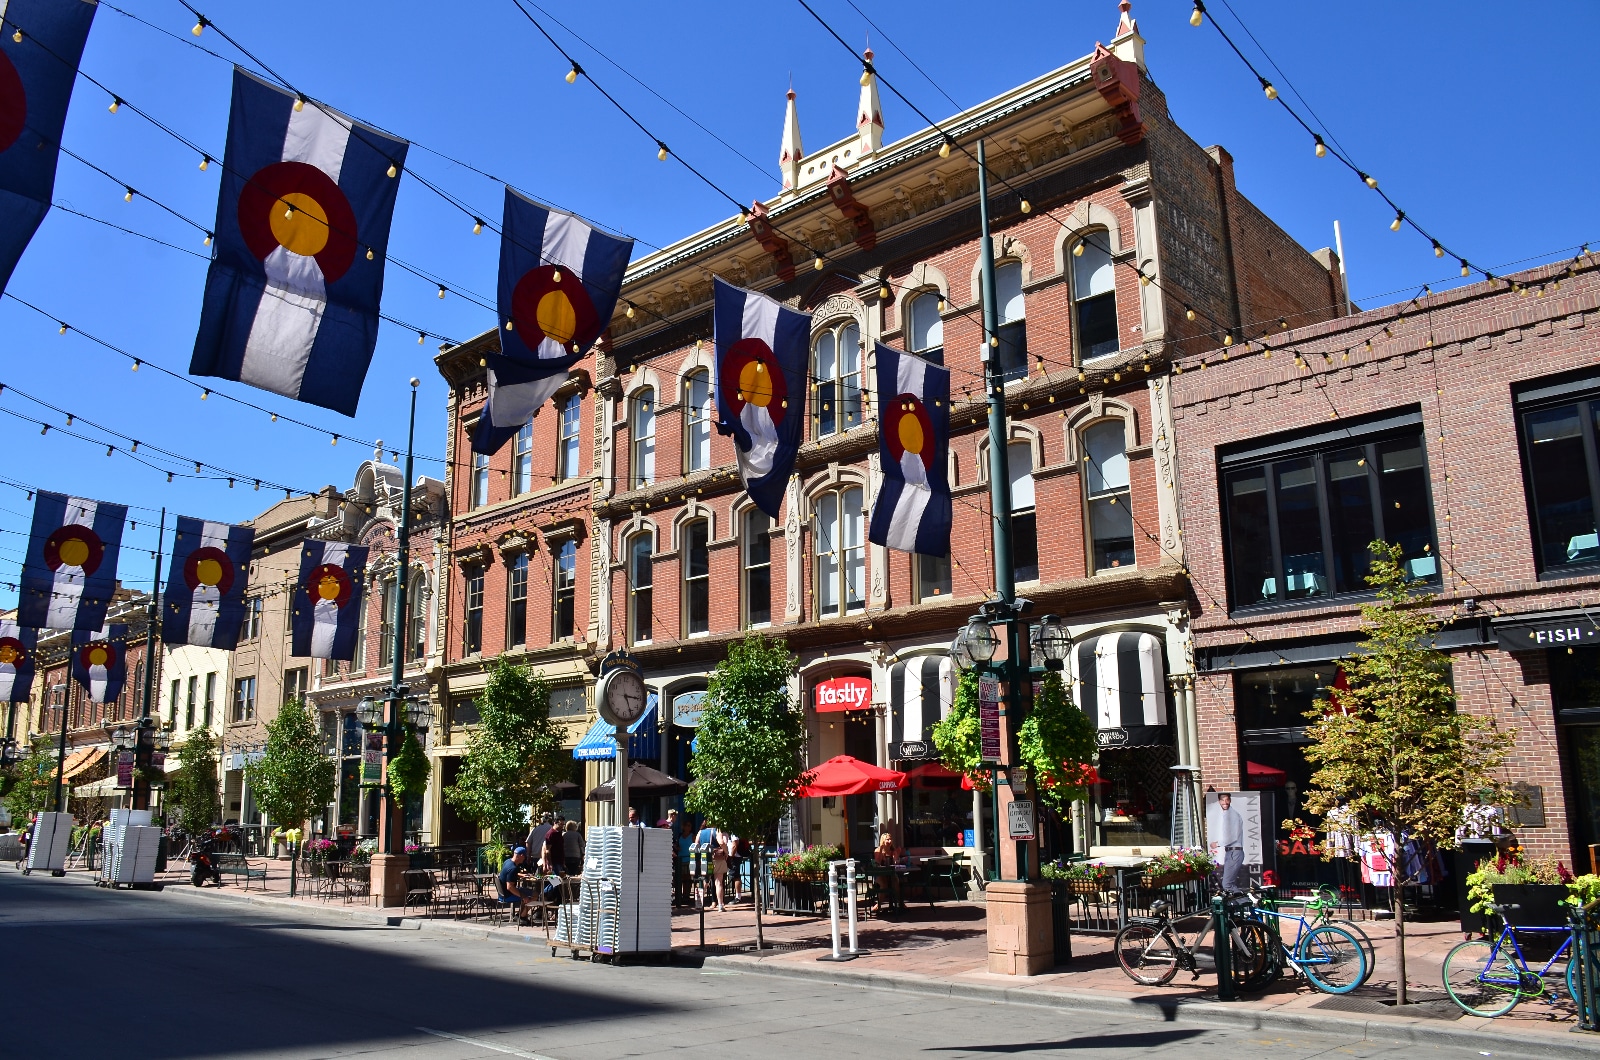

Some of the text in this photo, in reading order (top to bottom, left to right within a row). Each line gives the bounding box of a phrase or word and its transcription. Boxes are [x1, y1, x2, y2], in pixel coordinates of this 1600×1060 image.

[1536, 628, 1581, 644] FISH
[606, 659, 639, 669] THE MARKET
[589, 747, 613, 756] MARKET
[1281, 839, 1333, 856] SAL
